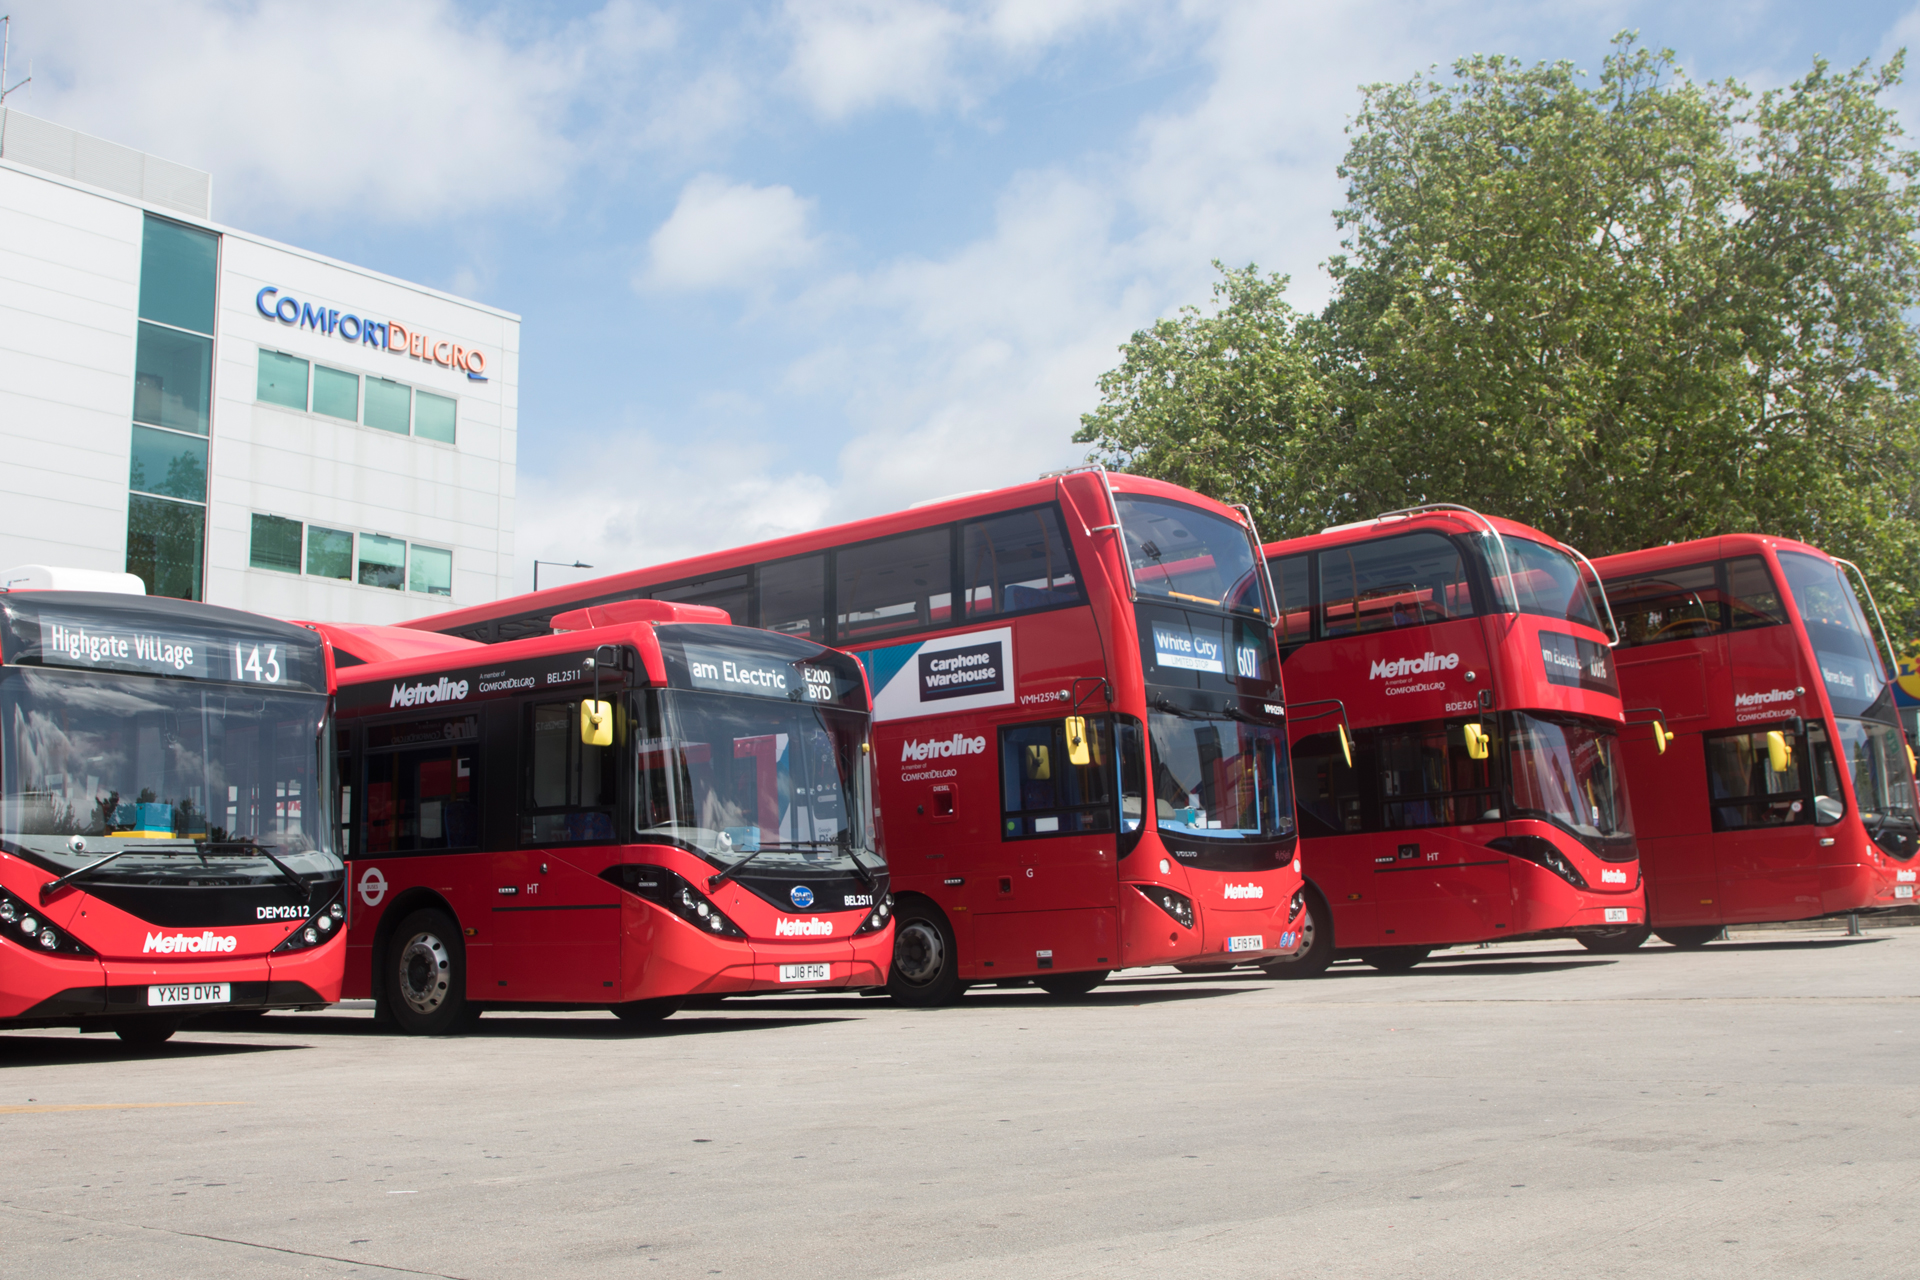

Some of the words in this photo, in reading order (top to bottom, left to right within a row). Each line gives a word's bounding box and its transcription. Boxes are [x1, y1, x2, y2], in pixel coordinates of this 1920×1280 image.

[256, 286, 488, 379] COMFORTDELGRO
[1156, 631, 1191, 652] White
[1194, 637, 1217, 660] City
[52, 625, 128, 661] Highgate
[134, 634, 193, 670] Village
[235, 641, 281, 683] 143
[1237, 646, 1256, 678] 607
[930, 653, 990, 672] Carphone
[1171, 657, 1194, 667] LIMITED
[1195, 660, 1209, 669] STOP
[1369, 652, 1459, 680] Metroline
[485, 671, 501, 679] member
[547, 670, 581, 684] BEL2511
[693, 662, 718, 680] am
[722, 661, 786, 689] Electric
[804, 668, 831, 684] E200
[926, 667, 996, 687] Warehouse
[390, 677, 469, 708] Metroline
[479, 677, 535, 693] COMFORTDELGRO
[808, 684, 832, 700] BYD
[1385, 682, 1446, 696] COMFORTDELGRO
[1020, 691, 1060, 705] VMH2594
[1735, 689, 1795, 707] Metroline
[901, 733, 986, 762] Metroline
[901, 769, 957, 782] COMFORTDELGRO
[1427, 852, 1439, 861] HT
[1026, 868, 1034, 878] G
[527, 884, 539, 894] HT
[1224, 882, 1264, 899] Metroline
[844, 895, 873, 906] BEL2511
[257, 905, 310, 919] DEM2612
[775, 917, 833, 936] Metroline
[142, 931, 237, 953] Metroline
[1233, 938, 1247, 949] LF19
[785, 966, 805, 979] LJ18
[808, 965, 824, 978] FHG
[158, 986, 189, 1002] YX19
[194, 985, 221, 1000] OVR
